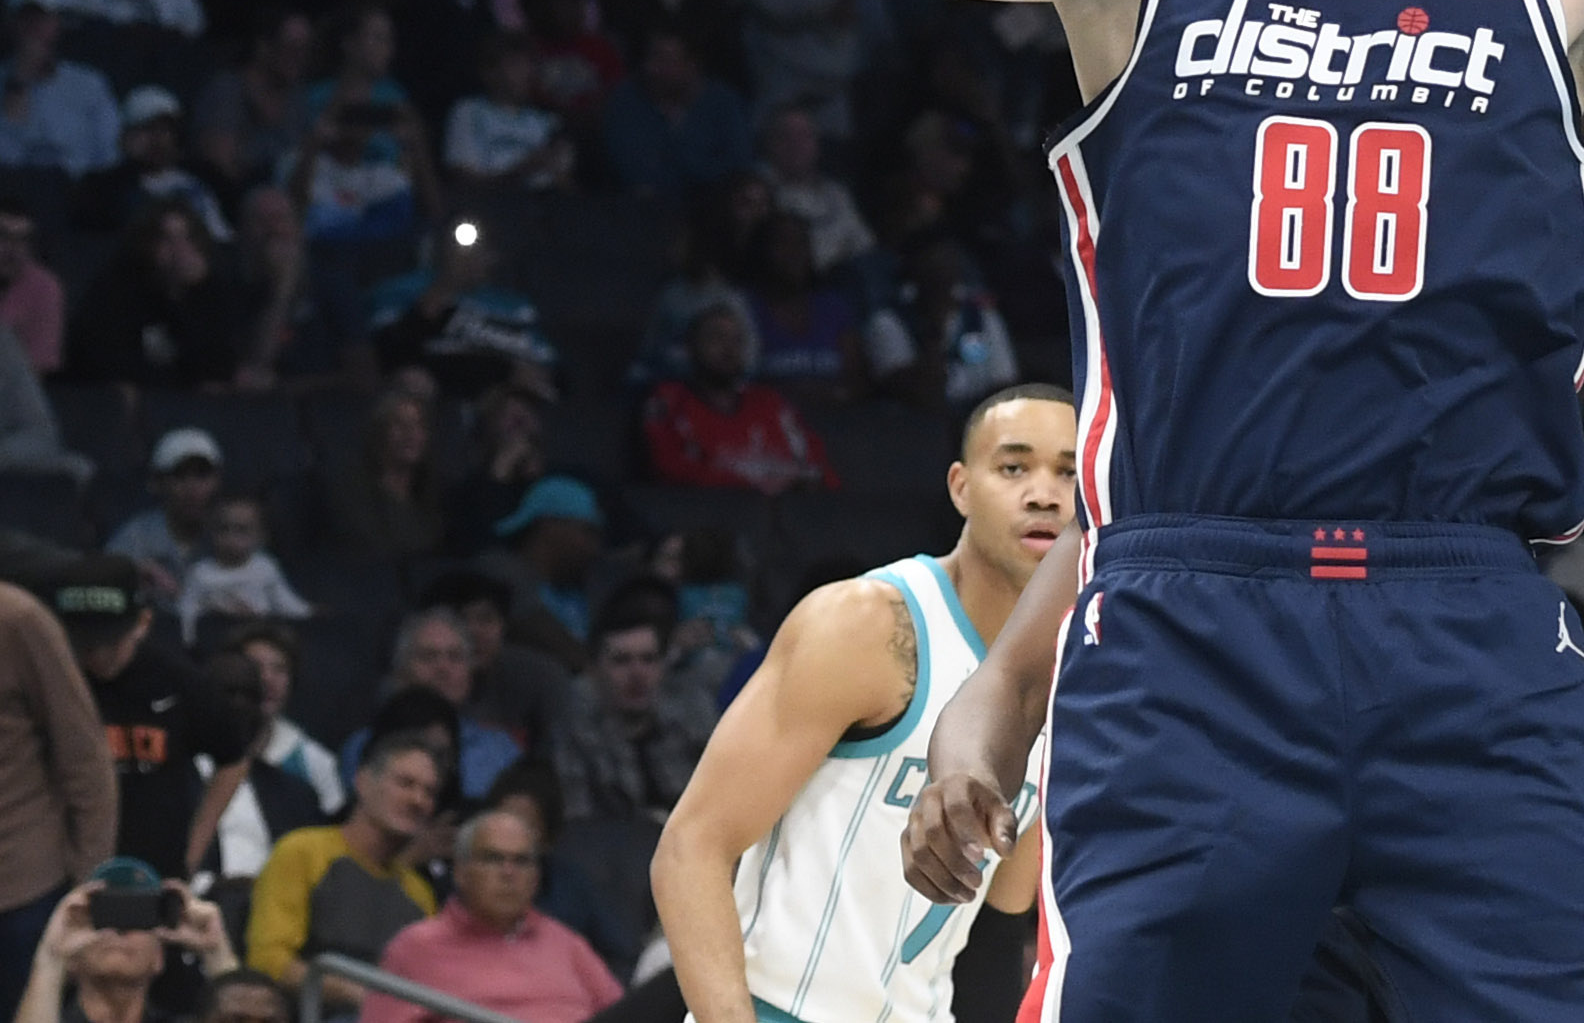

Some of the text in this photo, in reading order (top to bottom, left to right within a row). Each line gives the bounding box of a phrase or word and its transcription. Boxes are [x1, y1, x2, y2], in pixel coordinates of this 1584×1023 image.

[1268, 3, 1321, 28] THE
[1173, 79, 1489, 113] OF COLUMBIA
[1248, 115, 1432, 302] 88
